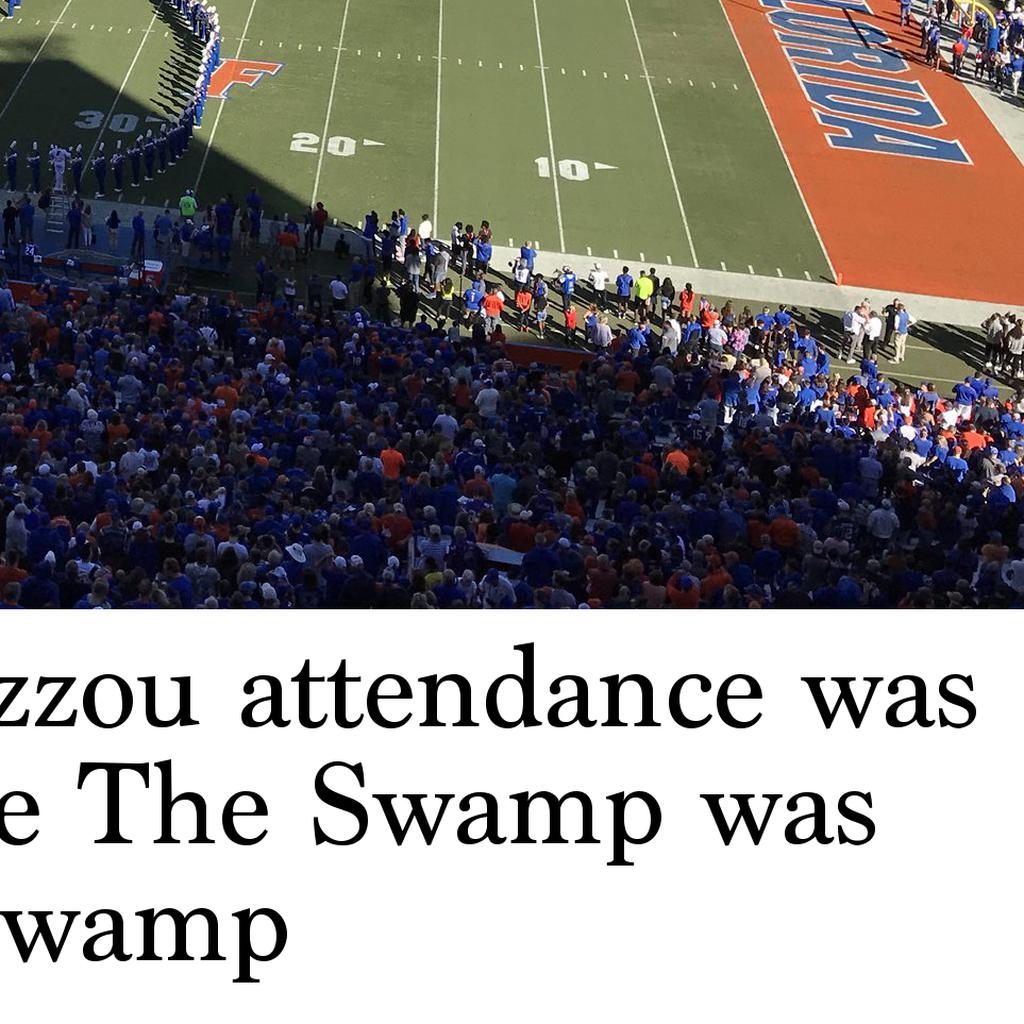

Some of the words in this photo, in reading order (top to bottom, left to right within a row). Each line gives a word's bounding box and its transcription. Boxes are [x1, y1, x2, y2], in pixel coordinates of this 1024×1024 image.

[74, 110, 140, 133] 30
[289, 132, 358, 156] 20
[534, 156, 590, 181] 10
